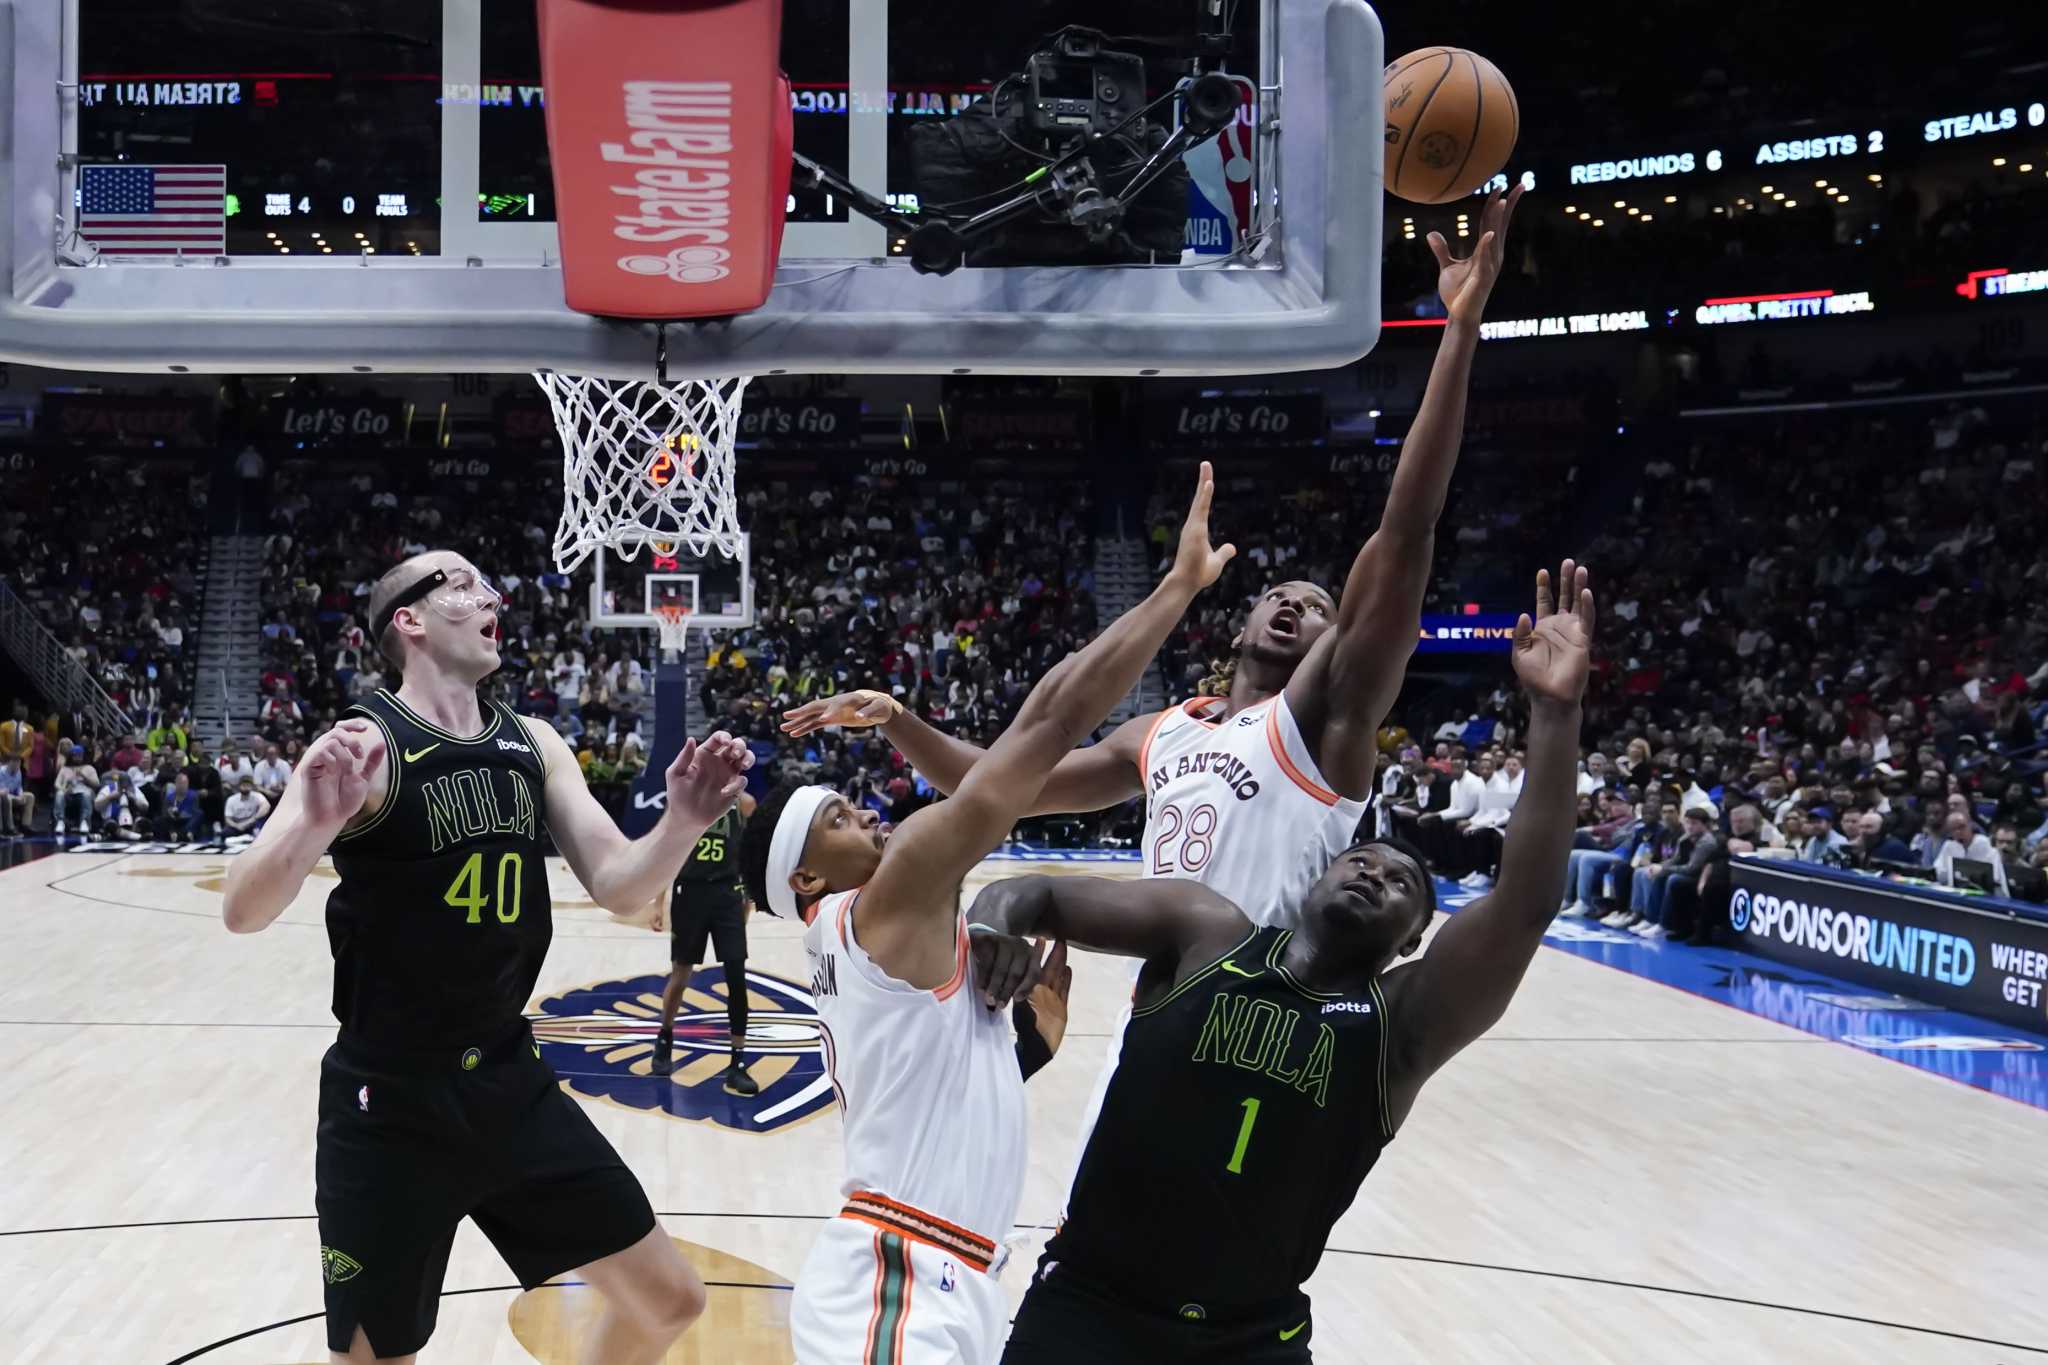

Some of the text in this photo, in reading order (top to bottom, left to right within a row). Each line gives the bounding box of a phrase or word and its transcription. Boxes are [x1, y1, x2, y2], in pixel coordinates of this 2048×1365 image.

[1924, 103, 2046, 142] STEALS 0
[1756, 131, 1884, 165] ASSISTS 2
[1571, 150, 1722, 185] REBOUNDS 6
[298, 197, 311, 213] 4
[343, 197, 355, 214] 0
[1184, 217, 1223, 246] NBA
[1540, 317, 1567, 335] ALL
[1569, 314, 1599, 333] THE
[1600, 311, 1649, 331] LOCAL
[283, 407, 390, 434] Let's Go
[742, 405, 837, 433] et's Go
[1177, 405, 1289, 434] Let's Go
[467, 458, 491, 476] Go
[1175, 752, 1260, 801] ANTONIO
[422, 768, 535, 852] NOLA
[697, 838, 725, 862] 25
[1153, 803, 1218, 875] 28
[443, 853, 522, 924] 40
[1750, 893, 1976, 987] SPONSORUNITED
[1321, 1001, 1371, 1014] ibotta
[2003, 976, 2042, 1008] GET
[1192, 993, 1335, 1108] NOLA
[1226, 1097, 1261, 1174] 1
